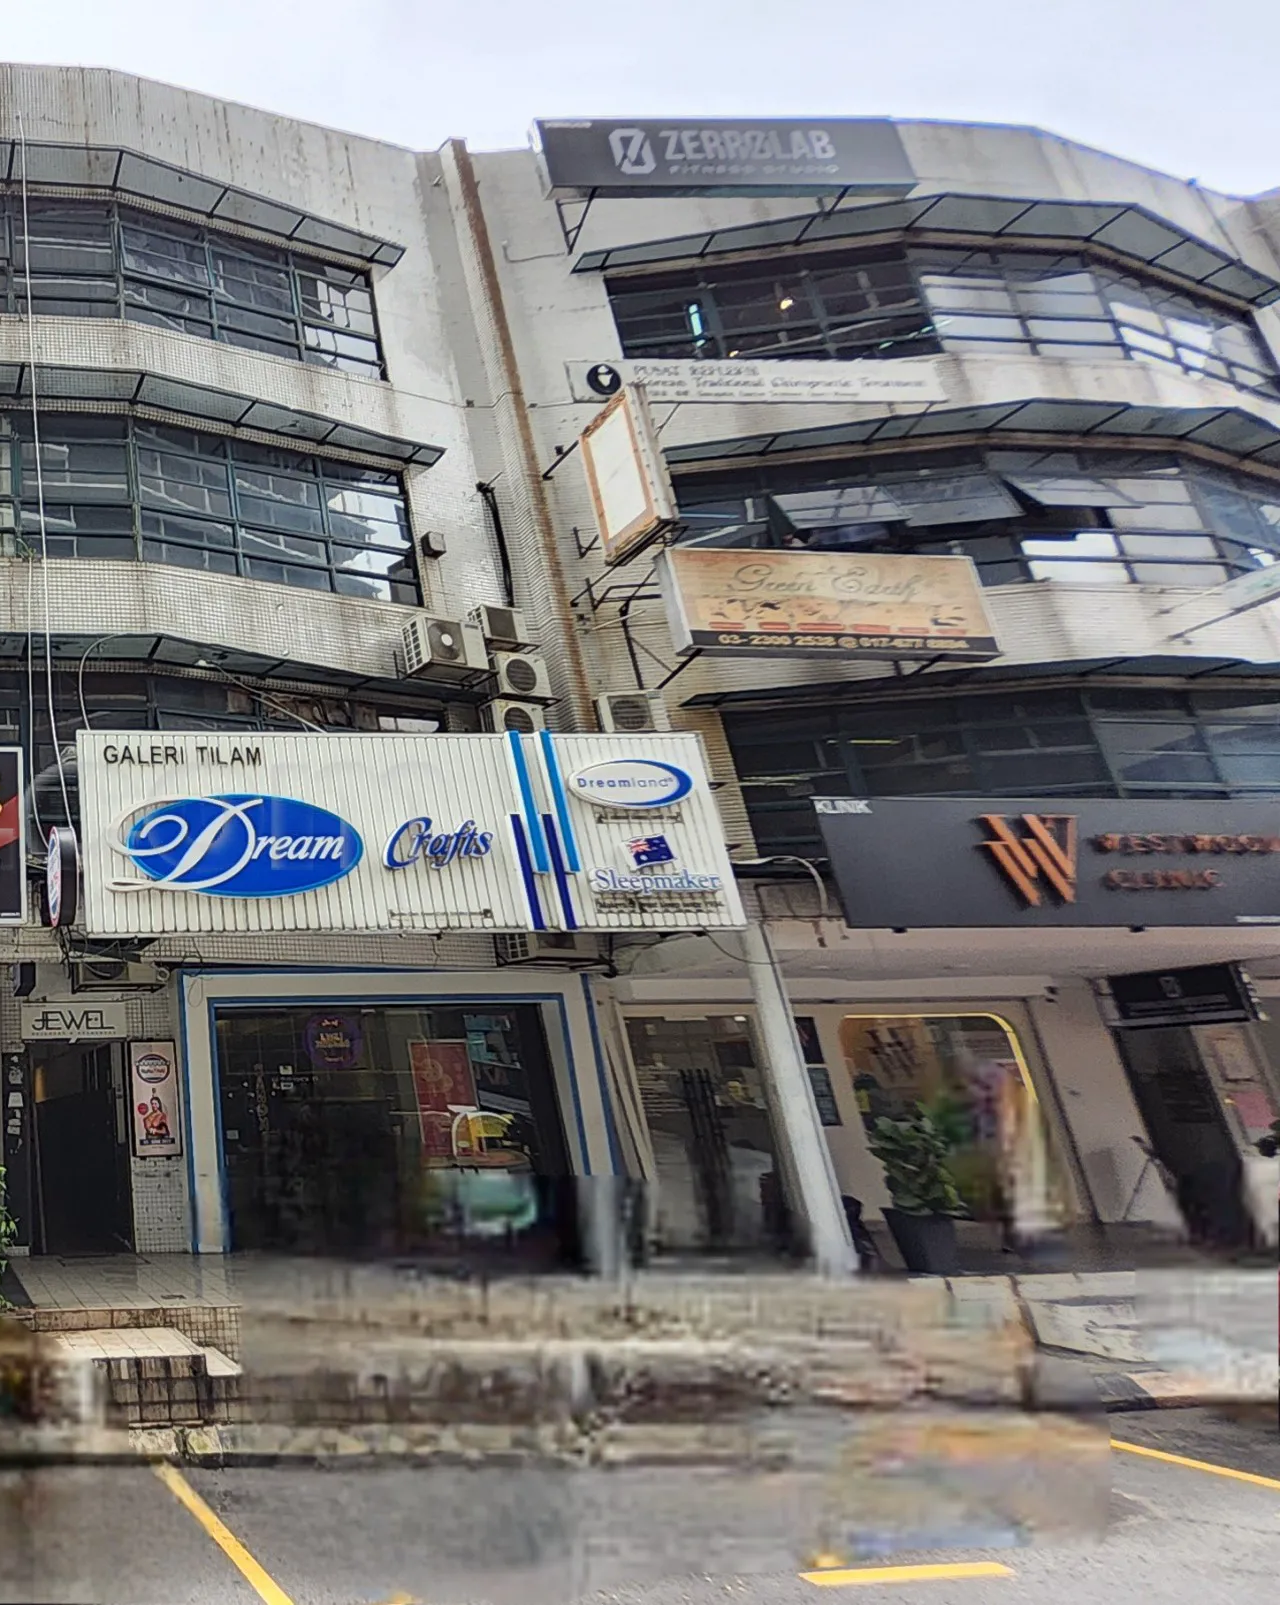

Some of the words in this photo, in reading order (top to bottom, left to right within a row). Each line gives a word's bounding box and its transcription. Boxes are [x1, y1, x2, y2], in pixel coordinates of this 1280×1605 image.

[103, 744, 186, 766] GALERI
[195, 745, 263, 767] TILAM
[105, 794, 344, 893] Dream
[383, 815, 494, 870] Crafts
[595, 867, 721, 895] Sleepmaker
[31, 1009, 116, 1031] JEWEL
